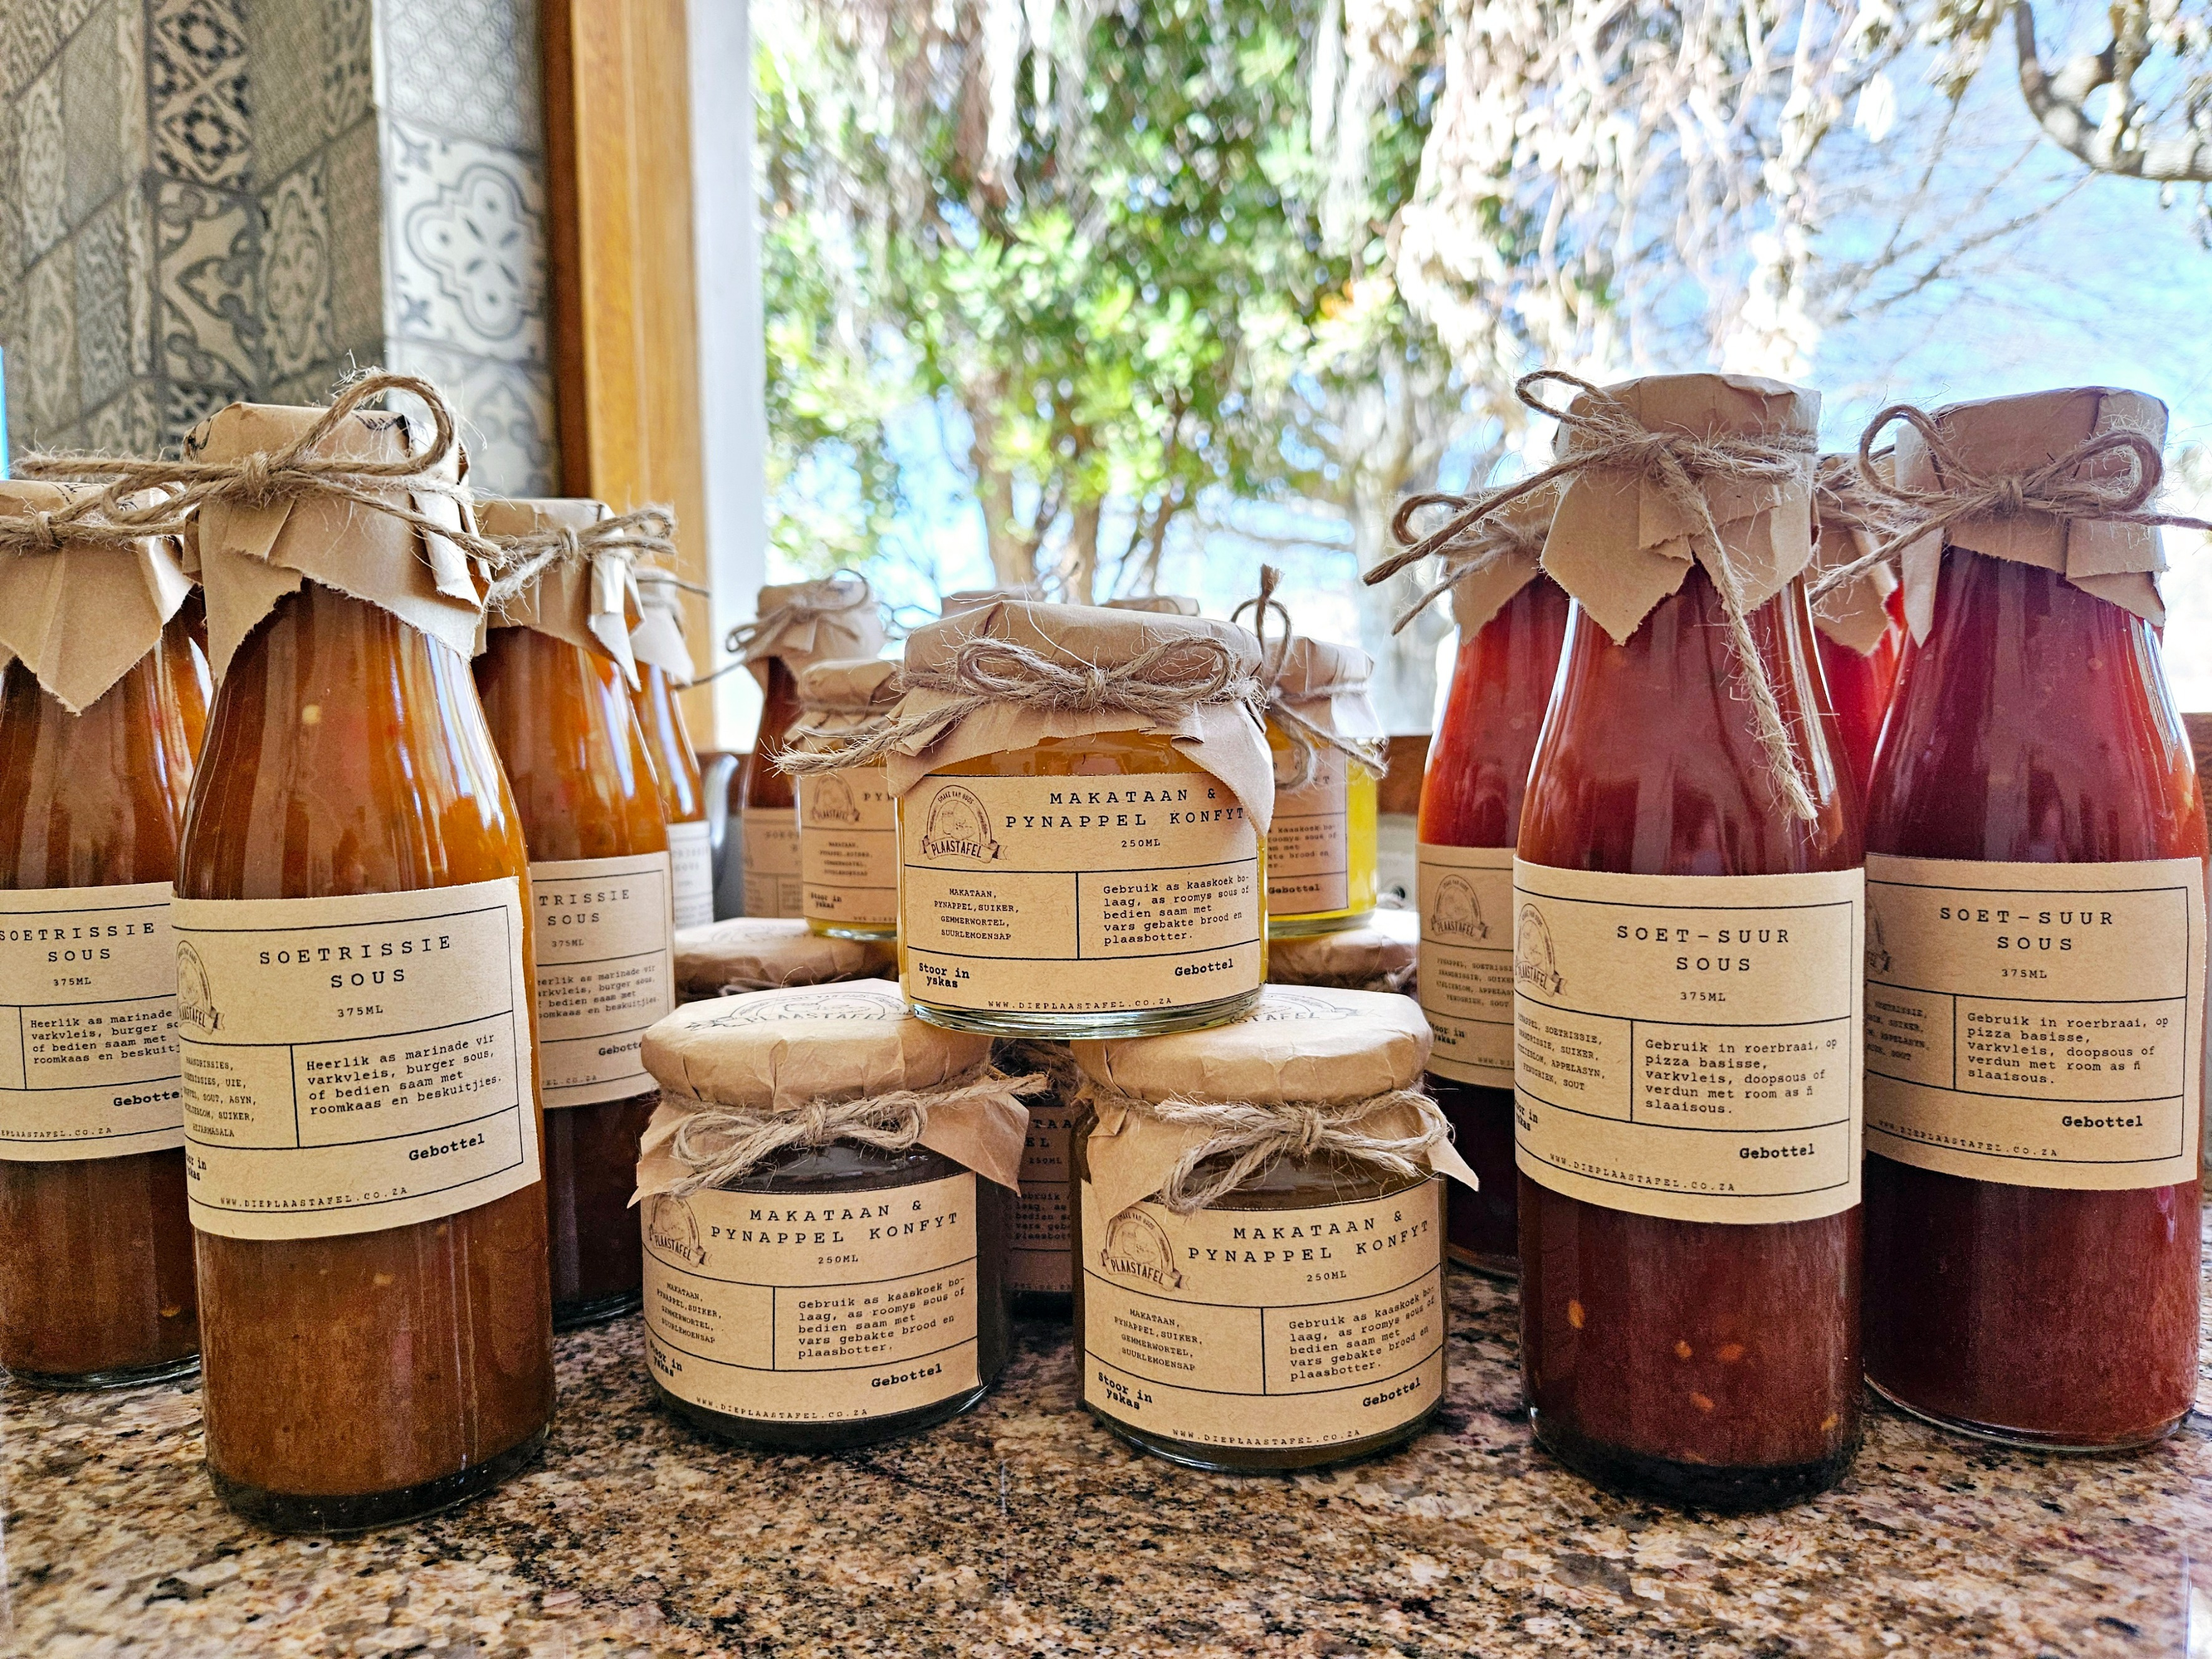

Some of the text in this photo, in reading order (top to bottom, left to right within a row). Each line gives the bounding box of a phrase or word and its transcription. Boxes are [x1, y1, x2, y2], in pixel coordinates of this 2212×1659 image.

[1050, 788, 1215, 804] MAKATAAN &
[1006, 808, 1244, 828] PYNAPPEL KONFYT
[931, 841, 981, 858] PLAASTAFEL
[1122, 839, 1161, 848] 250ML
[949, 888, 996, 898] MAKATAAN,
[1104, 883, 1158, 894] Gebruik
[1166, 883, 1179, 891] as
[1187, 876, 1233, 889] kaaskoek
[1268, 884, 1320, 894] Gebottel
[1104, 886, 1248, 907] laag, as roomys sous of
[548, 913, 599, 926] SOUS
[1104, 905, 1211, 919] bedien saam met
[1940, 907, 2112, 925] SOET-SUUR
[941, 916, 1010, 927] GEMMERWORTEL,
[1144, 919, 1194, 931] gebakte
[1201, 913, 1229, 925] brood
[1437, 919, 1473, 937] PLAASTAFEL
[942, 929, 1011, 940] SUURLEMOENSAP
[1104, 932, 1192, 946] plaasbotter.
[1617, 926, 1789, 943] SOET-SUUR
[260, 936, 450, 964] SOETRISSIE
[552, 939, 584, 947] 375ML
[1997, 937, 2072, 950] SOUS
[49, 949, 110, 962] SOUS
[919, 963, 970, 979] Stoor in
[1175, 959, 1234, 977] Gebottel
[1676, 957, 1750, 971] SOUS
[54, 977, 91, 986] 375ML
[331, 969, 405, 988] SOUS
[599, 968, 639, 980] marinade
[927, 975, 958, 987] yskas
[2002, 969, 2047, 979] 375ML
[599, 981, 630, 992] burger
[549, 997, 587, 1007] bedien
[988, 997, 1172, 1010] WWW.DIEPLAASTAFEL.CO.ZA
[1681, 992, 1726, 1002] 375ML
[31, 1010, 172, 1028] Heerlik marinade
[337, 1005, 384, 1018] 375ML
[1968, 1013, 2147, 1028] Gebruik roerbraai,
[32, 1024, 157, 1040] varkvleis, burger
[1545, 1026, 1602, 1045] SOETRISSIE,
[1968, 1028, 2090, 1043] pizza basisse,
[52, 1035, 167, 1052] bedien saam met
[307, 1033, 494, 1070] Heerlik as marinade vir
[1646, 1038, 1836, 1053] Gebruik in roerbraai, op
[1968, 1042, 2133, 1058] varkvleis, doopsous
[34, 1054, 89, 1064] roomkaas
[1561, 1046, 1598, 1060] SUIKER,
[1968, 1056, 2019, 1066] verdun
[307, 1051, 493, 1084] varkvleis, burger sous,
[1552, 1060, 1605, 1079] APPELASYN,
[1646, 1055, 1767, 1070] pizza basisse,
[226, 1079, 246, 1088] UIE,
[1646, 1070, 1825, 1086] varkvleis, doopsous of
[1968, 1070, 2054, 1083] slaaisous.
[309, 1071, 463, 1100] of bedien saam met
[1563, 1080, 1584, 1090] SOUT
[1646, 1086, 1799, 1099] verdun met room as
[113, 1091, 183, 1106] Gebotte
[229, 1096, 256, 1105] ASYN,
[311, 1077, 501, 1115] roomkaas en beskuitjies.
[1646, 1100, 1732, 1113] slaaisous.
[219, 1112, 254, 1122] SUIKER,
[2062, 1115, 2143, 1128] Gebottel
[408, 1133, 485, 1161] Gebottel
[1740, 1143, 1815, 1159] Gebottel
[750, 1200, 922, 1221] MAKATAAN &
[711, 1212, 957, 1243] PYNAPPEL KONFYT
[1234, 1211, 1402, 1239] MAKATAAN &
[655, 1234, 691, 1260] PLAASTAFEL
[1189, 1221, 1429, 1262] PYNAPPEL KONFYT
[818, 1254, 858, 1264] 250ML
[1111, 1259, 1163, 1285] PLAASTAFEL
[1307, 1270, 1346, 1282] 250ML
[799, 1282, 942, 1309] Gebruik kaaskoek
[799, 1303, 915, 1322] laag, roomys
[1130, 1308, 1180, 1327] MAKATAAN,
[1289, 1294, 1419, 1329] Gebruik kaaskoek
[799, 1325, 846, 1333] bedien
[799, 1320, 935, 1345] vars gebakte brood
[1290, 1317, 1399, 1342] laag, roomys
[799, 1343, 892, 1359] plaasbotter.
[1290, 1344, 1337, 1354] bedien
[1291, 1333, 1415, 1366] vars gebakte brood
[1122, 1347, 1195, 1371] SUURLEMOENSAP
[872, 1363, 942, 1387] Gebottel
[1290, 1361, 1381, 1381] plaasbotter.
[1098, 1372, 1152, 1403] Stoor in
[1363, 1377, 1421, 1407] Gebottel
[1106, 1388, 1140, 1410] yskas
